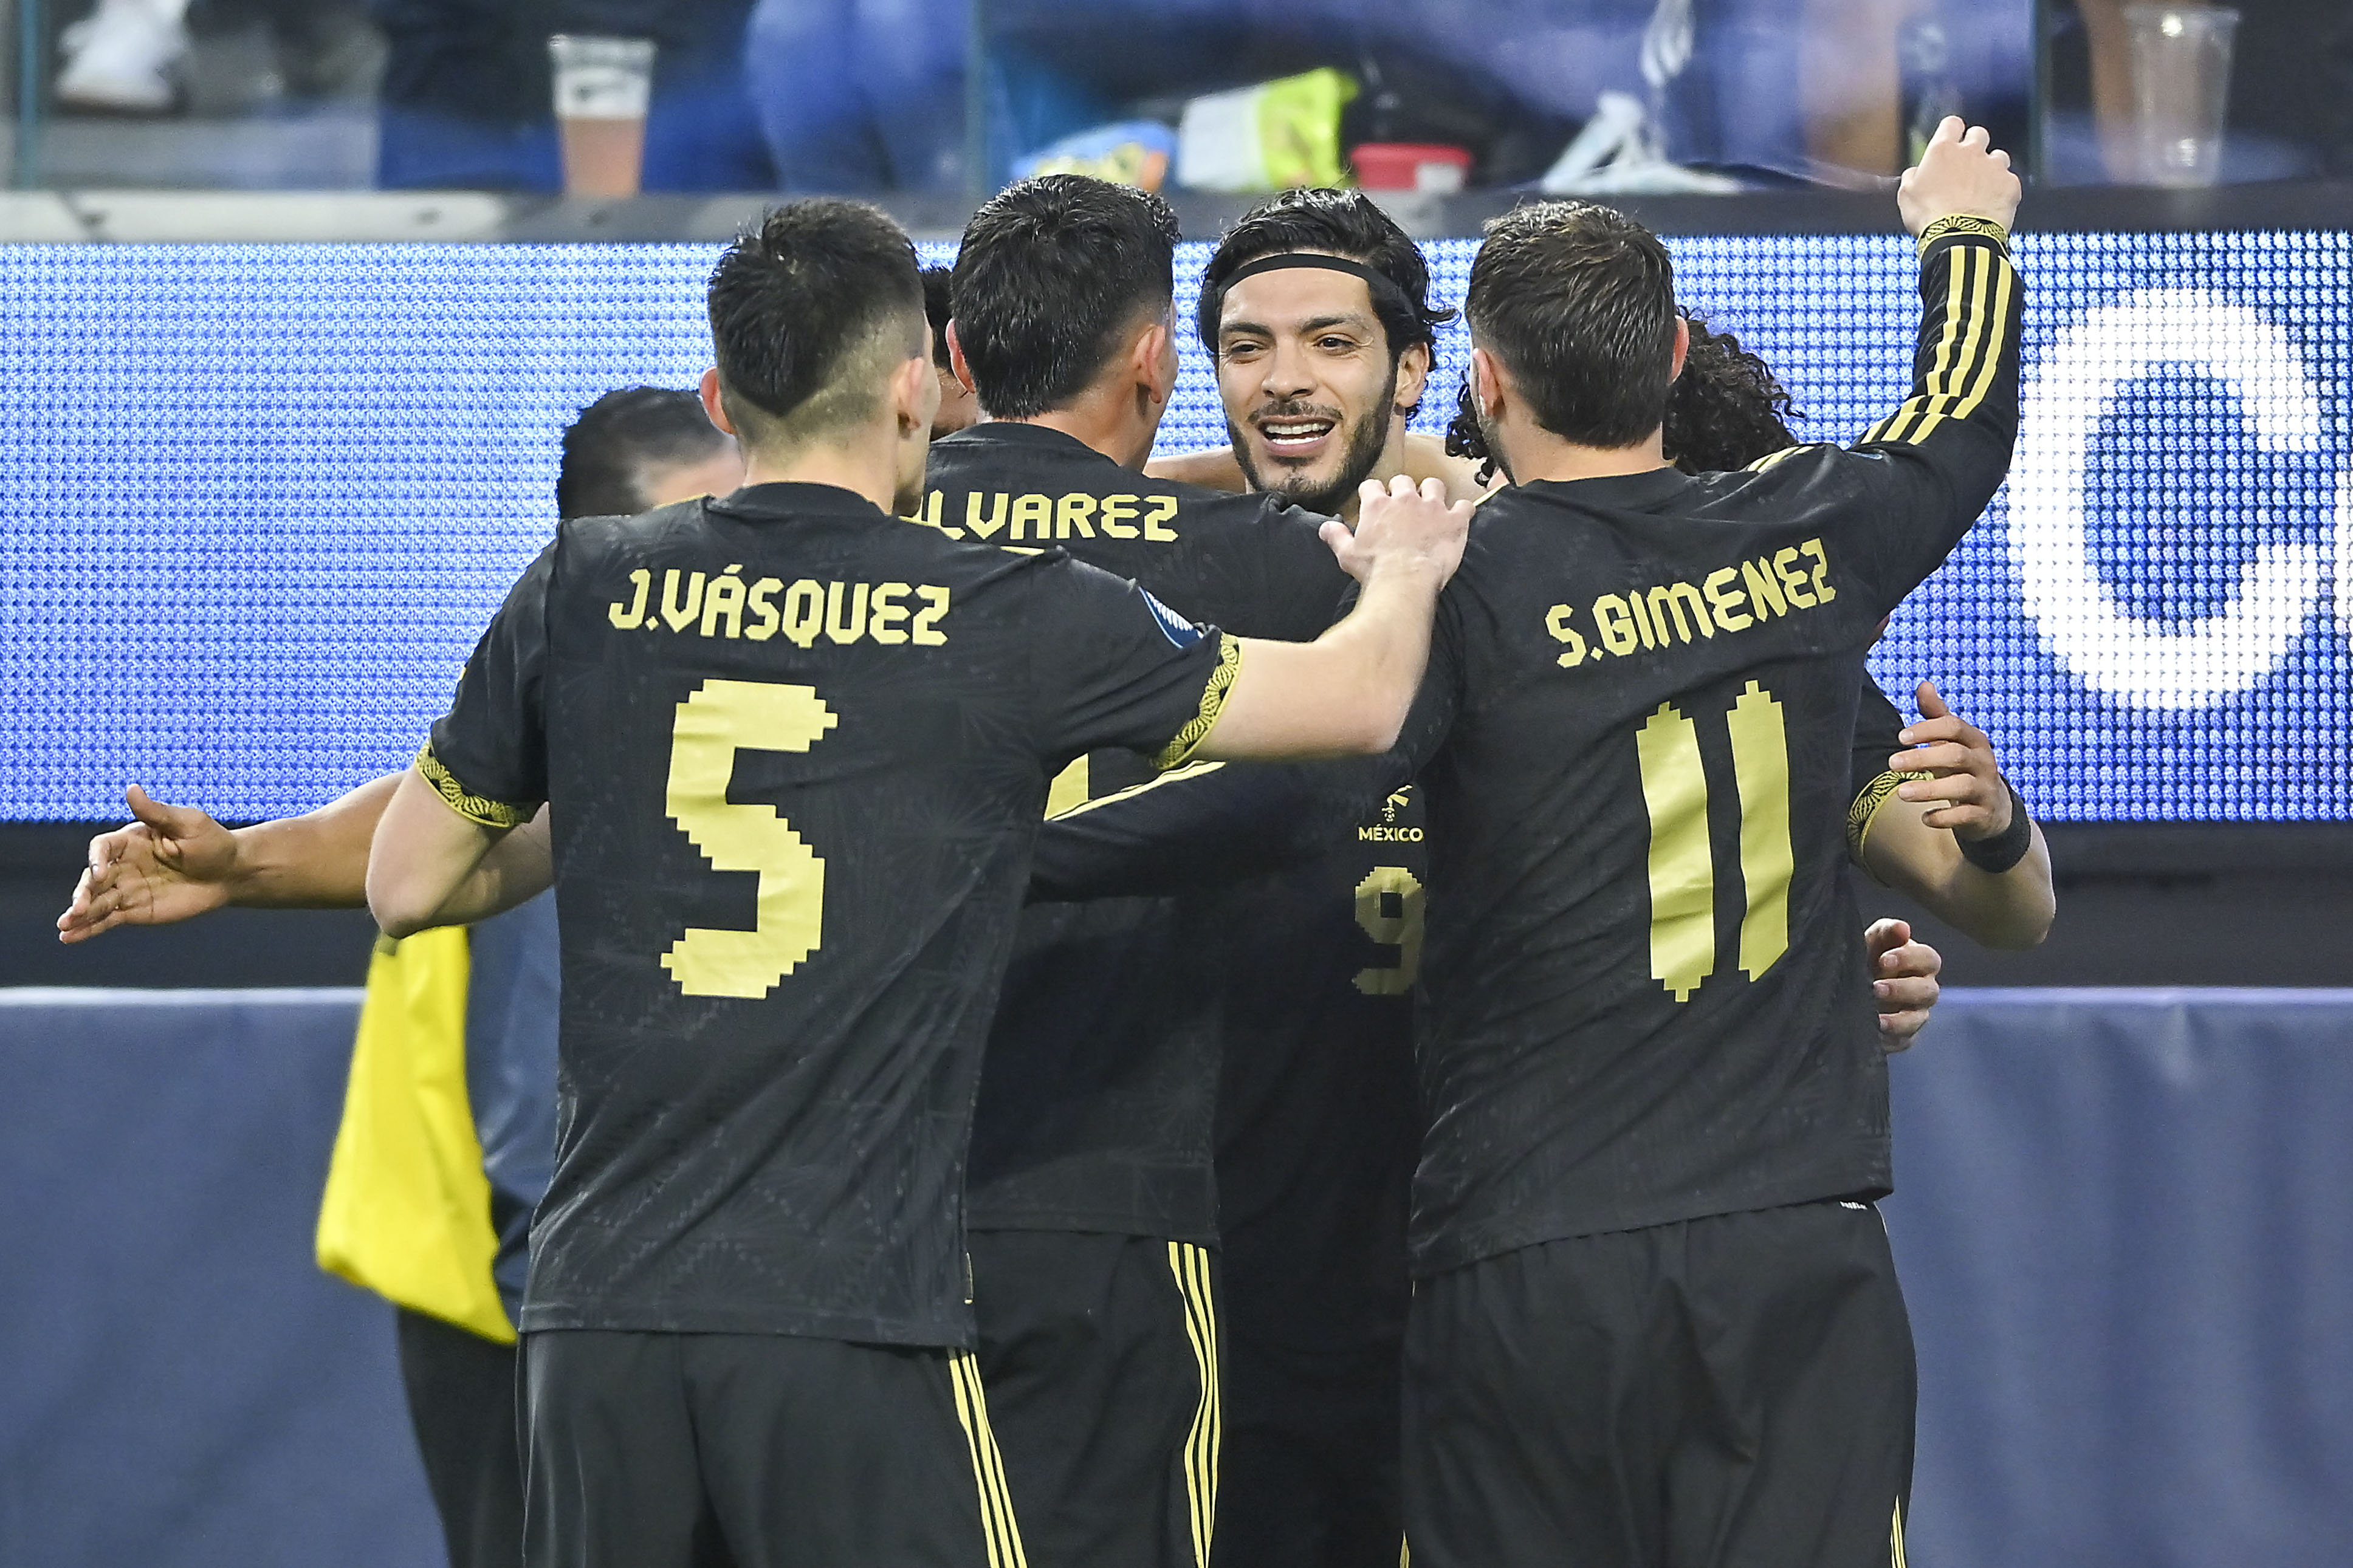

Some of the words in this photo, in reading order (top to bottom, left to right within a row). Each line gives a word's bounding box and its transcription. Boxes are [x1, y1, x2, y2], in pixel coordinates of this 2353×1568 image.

[916, 489, 1179, 542] LVAREZ
[608, 564, 950, 649] J.VÁSQUEZ
[1545, 538, 1836, 668] S.GIMENEZ
[660, 679, 839, 999] 5
[1358, 823, 1424, 843] MÉXICO
[1635, 679, 1795, 1002] 11
[1352, 866, 1426, 995] 9
